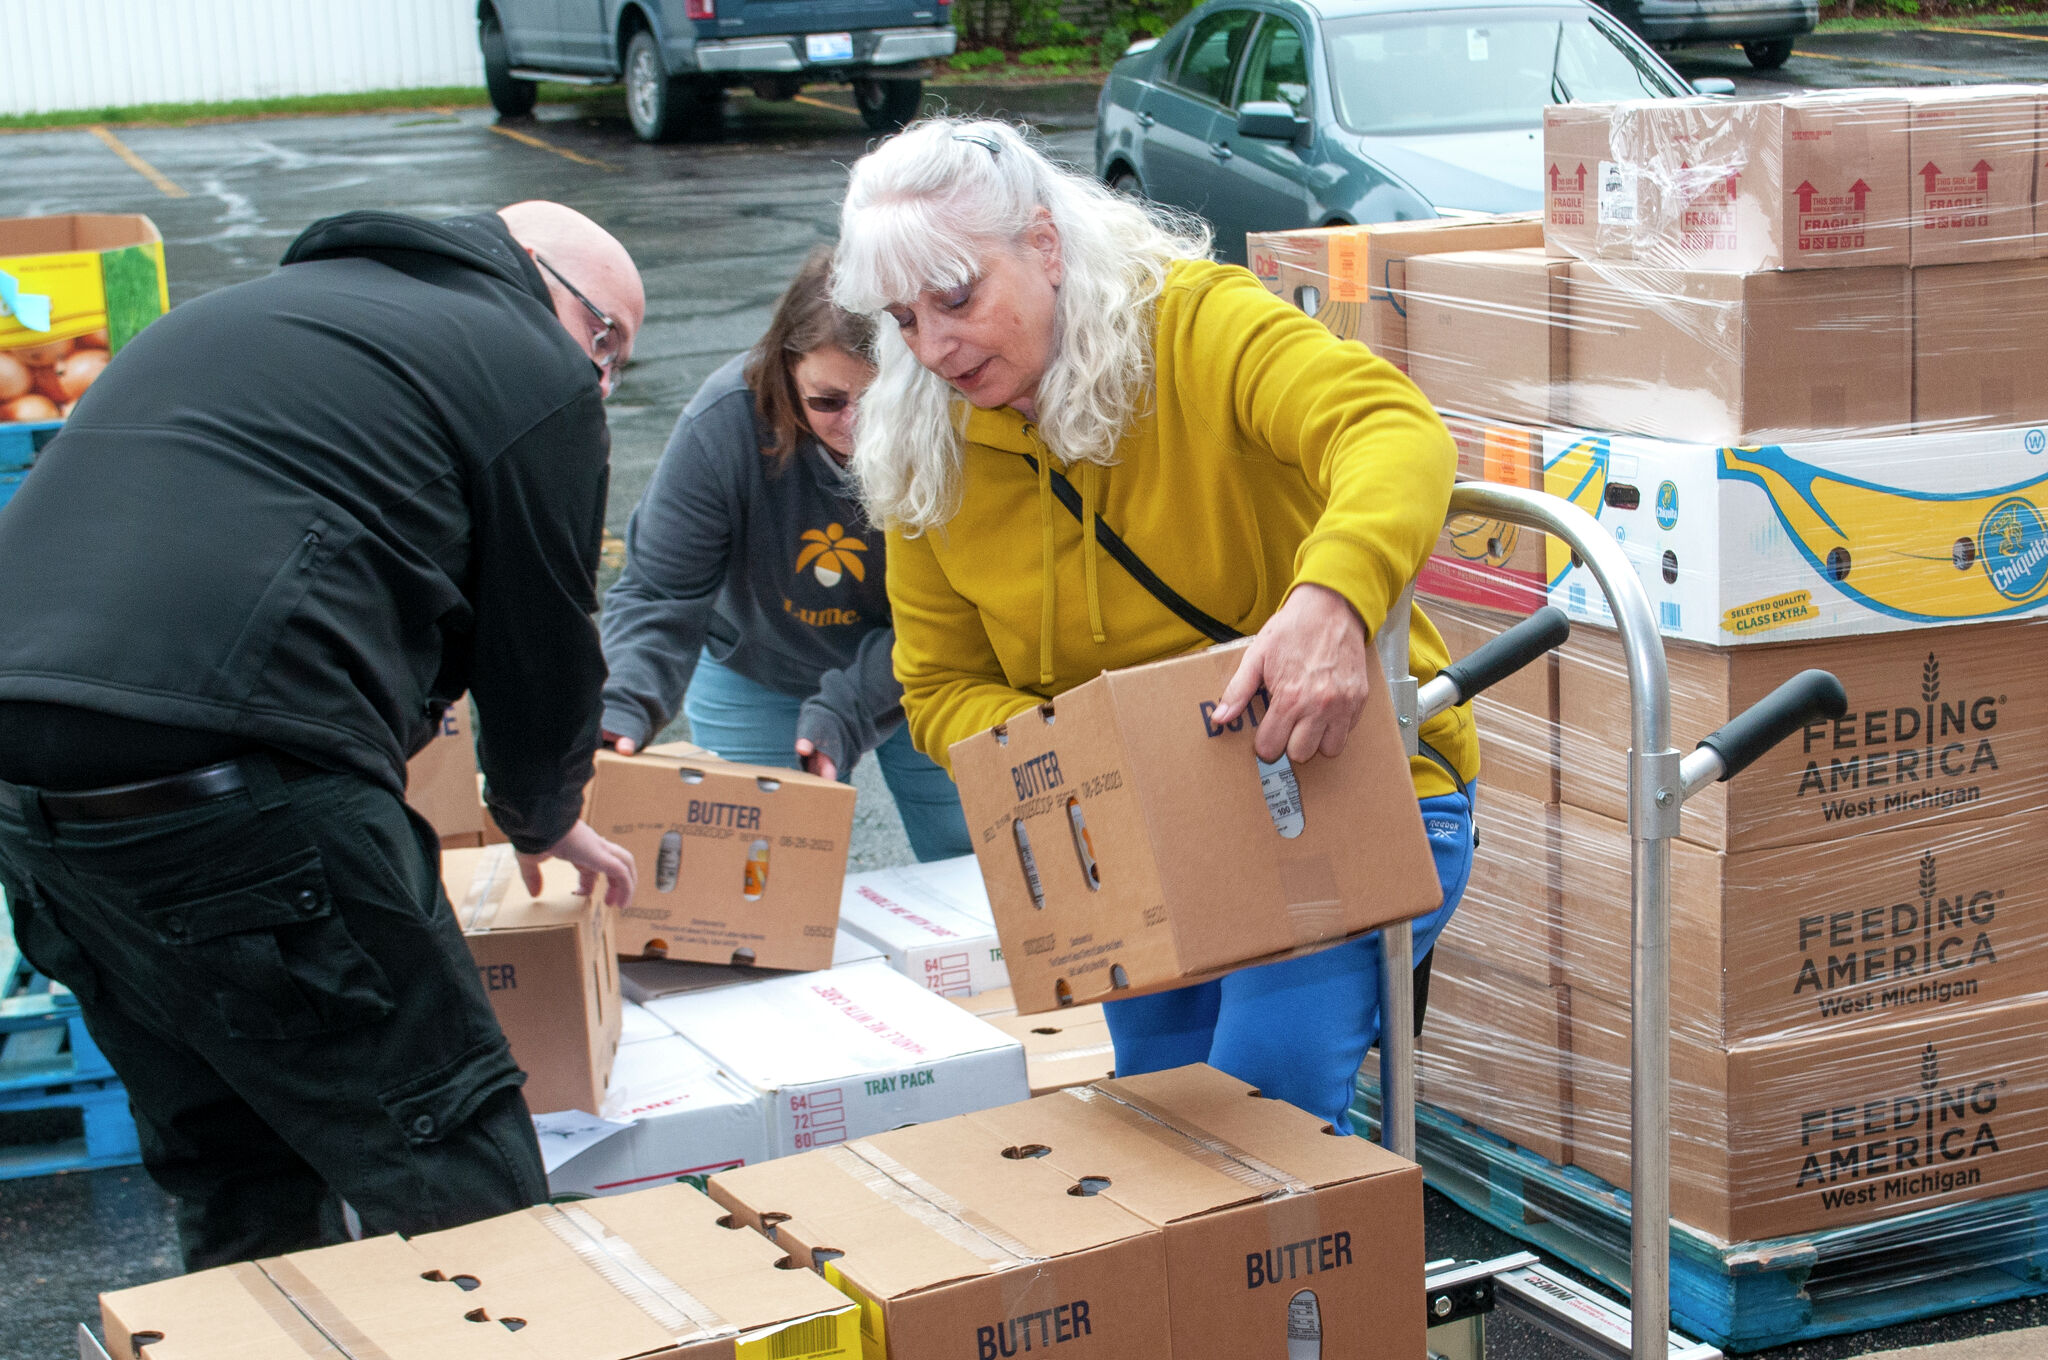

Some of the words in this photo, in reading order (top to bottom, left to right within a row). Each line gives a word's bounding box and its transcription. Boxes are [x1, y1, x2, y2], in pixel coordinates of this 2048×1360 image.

[1553, 197, 1582, 209] FRAGILE
[1929, 197, 1984, 211] FRAGILE
[1685, 211, 1734, 226] FRAGILE
[1804, 218, 1860, 231] FRAGILE
[1255, 254, 1279, 277] Dole
[1993, 537, 2048, 591] Chiquita
[1730, 602, 1772, 620] SELECTED
[1772, 593, 1807, 611] QUALITY
[1736, 614, 1772, 632] CLASS
[1772, 605, 1809, 624] EXTRA
[1011, 751, 1065, 801] BUTTER
[1797, 738, 1999, 797] AMERICA
[688, 800, 761, 830] BUTTER
[1277, 805, 1291, 816] 100
[1821, 797, 1877, 822] West
[1884, 785, 1981, 814] Michigan
[1429, 819, 1460, 831] Reebok
[924, 957, 939, 973] 64
[989, 947, 1005, 962] TR
[1793, 931, 1998, 995] AMERICA
[926, 974, 940, 989] 72
[1819, 992, 1874, 1018] West
[1881, 977, 1979, 1008] Michigan
[865, 1073, 897, 1096] TRAY
[900, 1069, 935, 1089] PACK
[790, 1094, 807, 1111] 64
[793, 1113, 810, 1130] 72
[794, 1132, 812, 1149] 80
[1796, 1122, 2000, 1188] AMERICA
[1821, 1183, 1877, 1210] West
[1884, 1167, 1981, 1199] Michigan
[1246, 1230, 1353, 1289] BUTTER
[977, 1300, 1092, 1360] BUTTER
